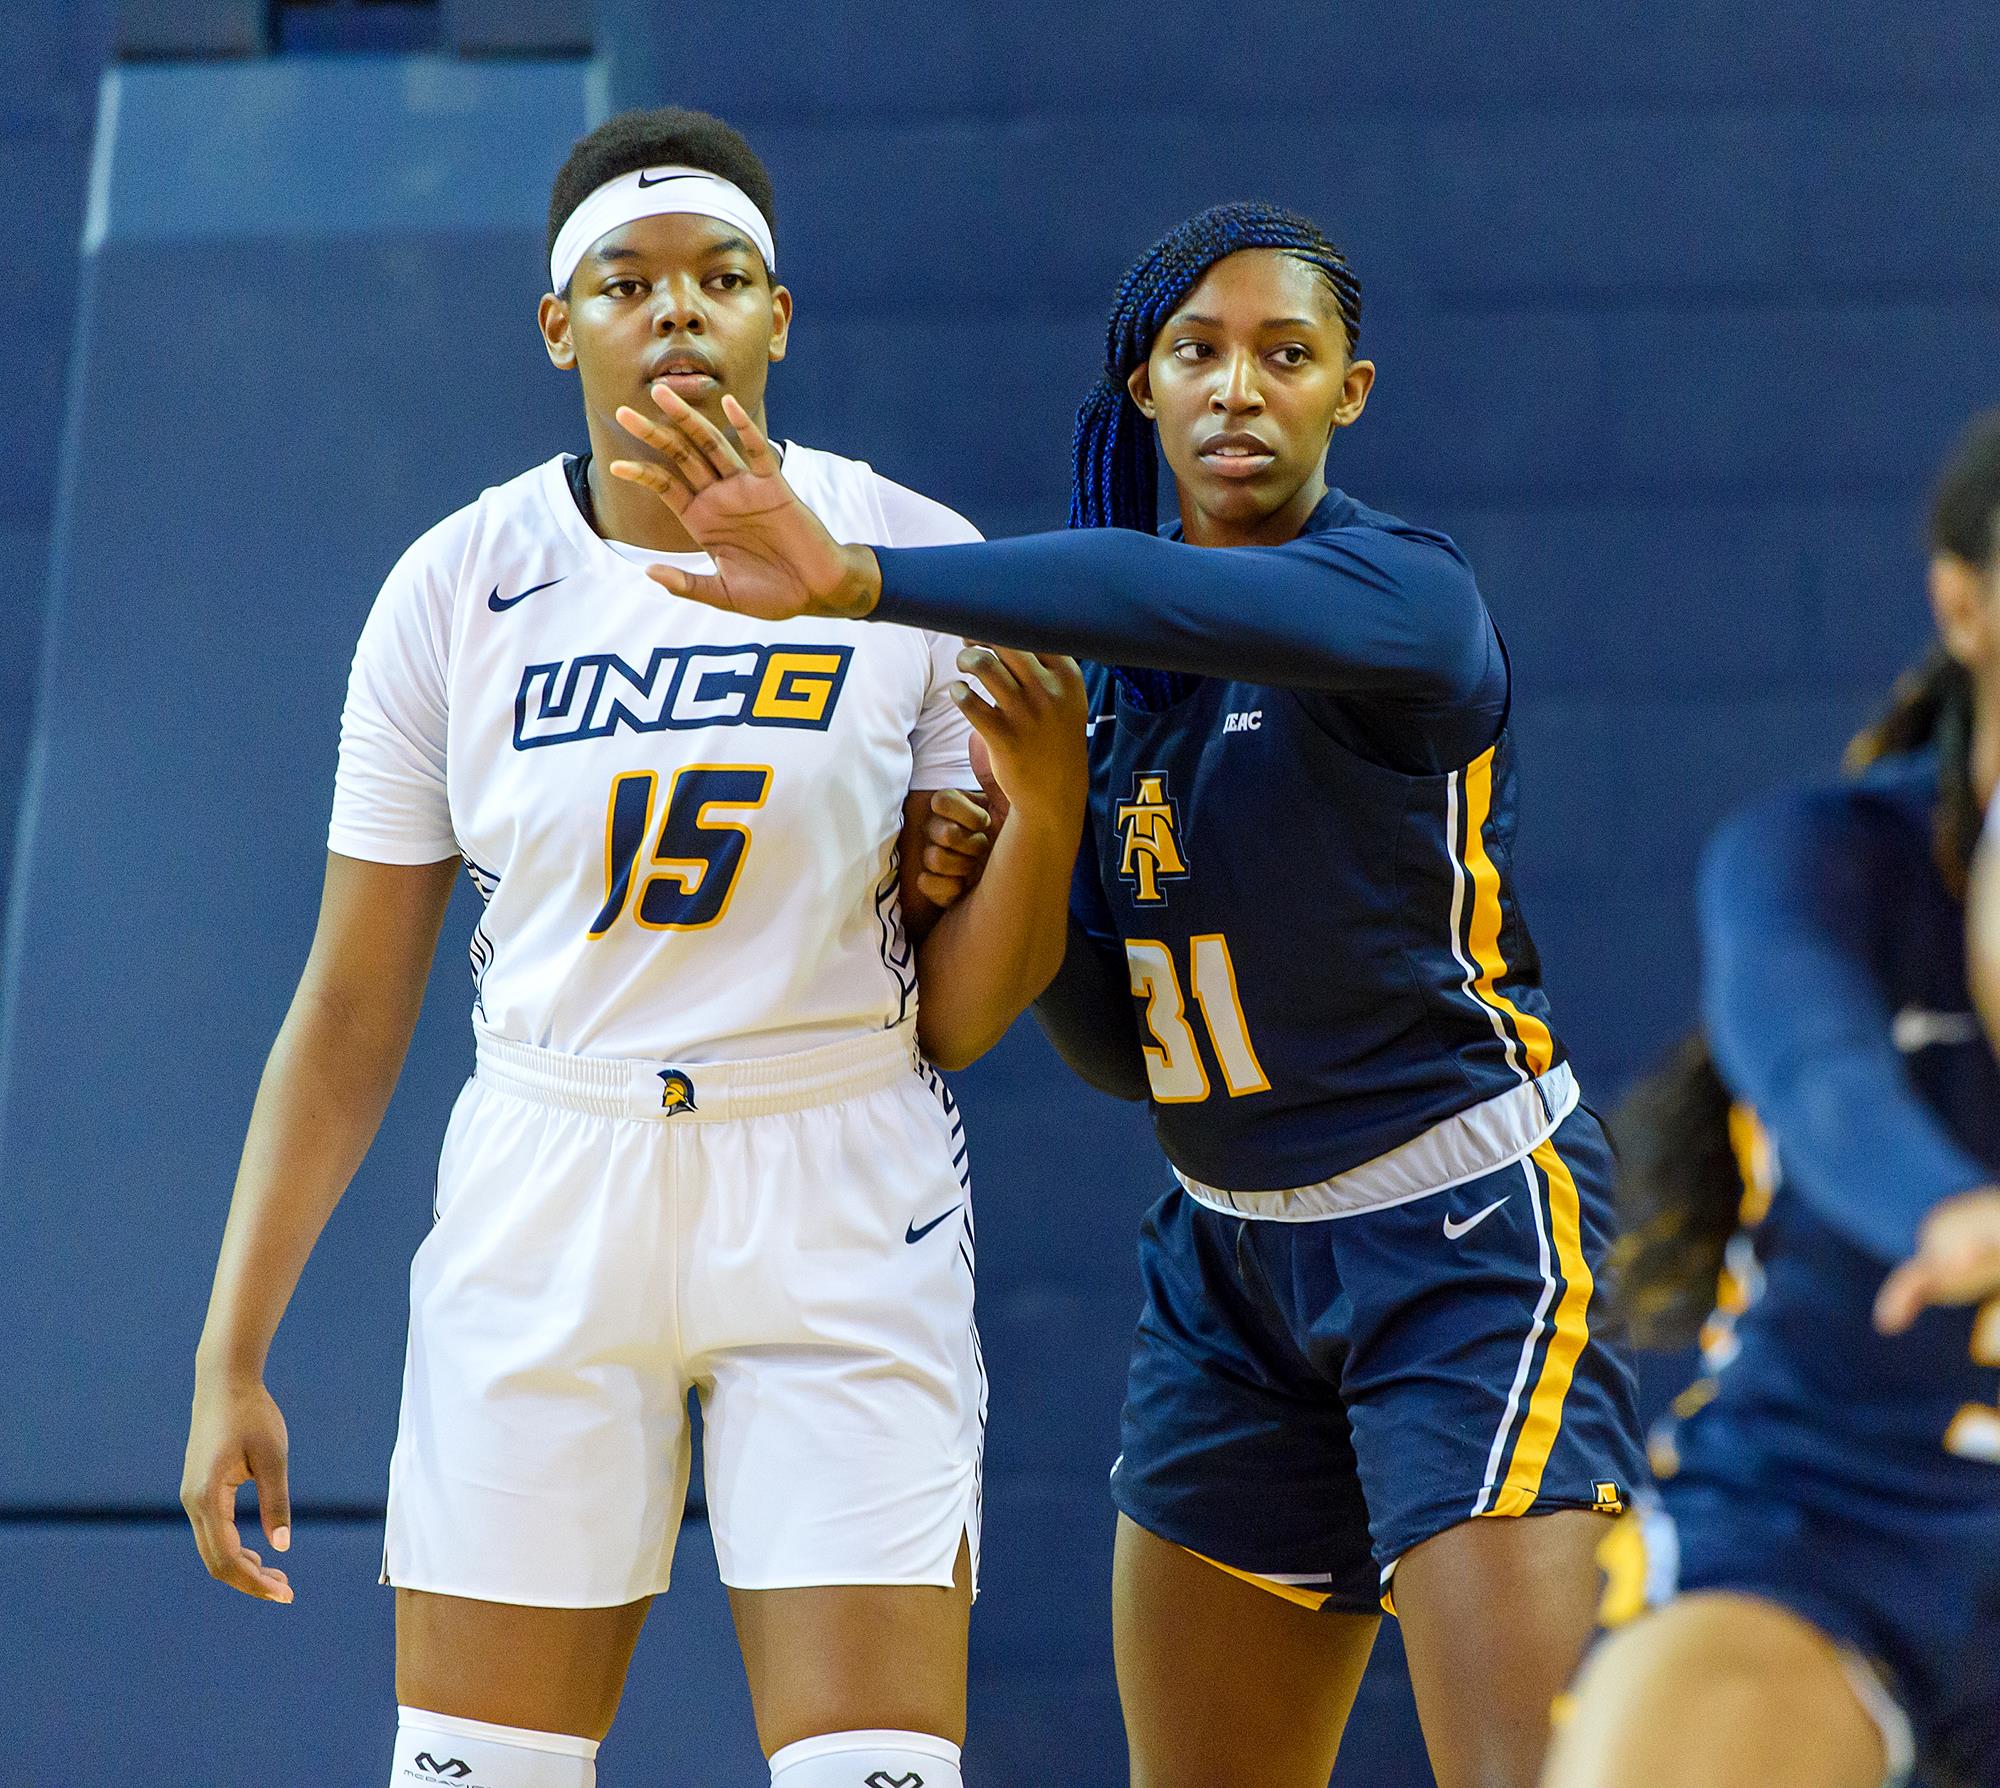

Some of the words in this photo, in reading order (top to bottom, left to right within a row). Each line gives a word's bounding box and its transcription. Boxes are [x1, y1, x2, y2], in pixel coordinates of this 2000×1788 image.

[513, 643, 854, 750] UNCG
[586, 763, 774, 940] 15
[1125, 933, 1272, 1104] 31
